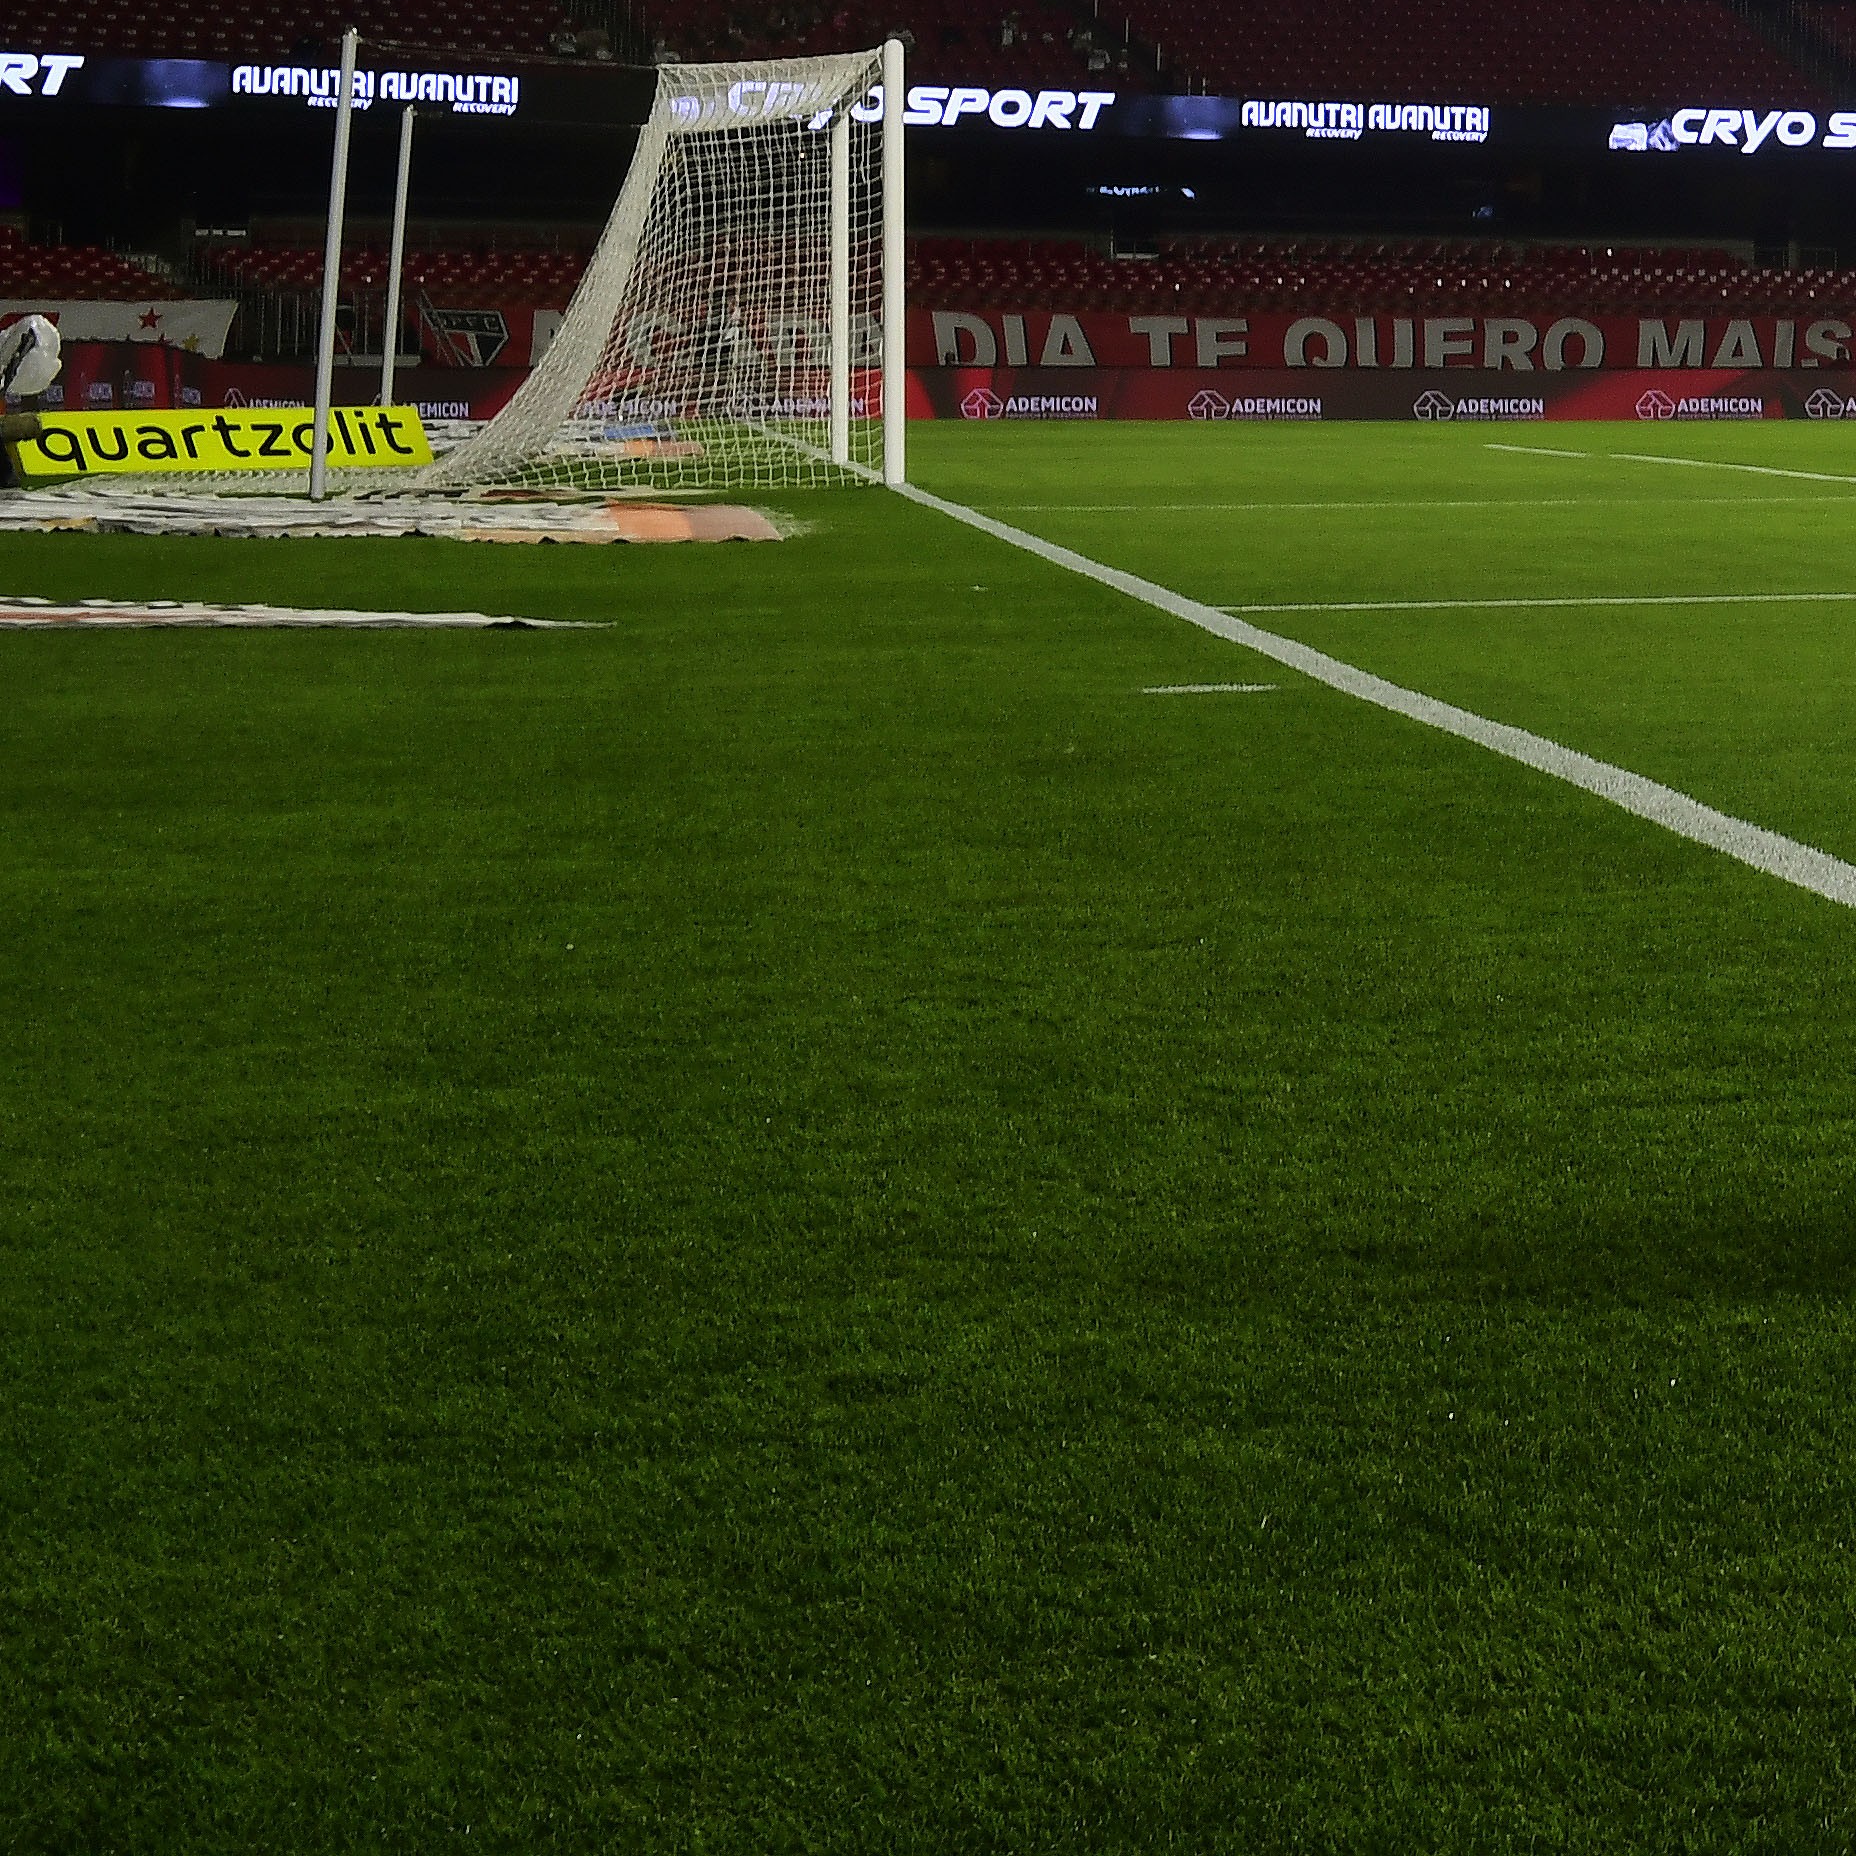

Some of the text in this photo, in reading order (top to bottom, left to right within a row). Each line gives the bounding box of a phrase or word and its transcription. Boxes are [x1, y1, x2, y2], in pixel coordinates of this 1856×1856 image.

[380, 72, 519, 107] AVANUTRI
[903, 86, 1115, 130] SPORT
[1242, 100, 1488, 131] AVANUTRI AVANUTRI
[1671, 108, 1816, 153] CRYO
[931, 311, 1098, 368] DIA
[1637, 319, 1853, 369] MAIS
[1006, 397, 1097, 414] ADEMICON
[1232, 398, 1321, 414] ADEMICON
[1456, 398, 1544, 414] ADEMICON
[1678, 398, 1762, 414] ADEMICON
[36, 410, 415, 471] quartzolit
